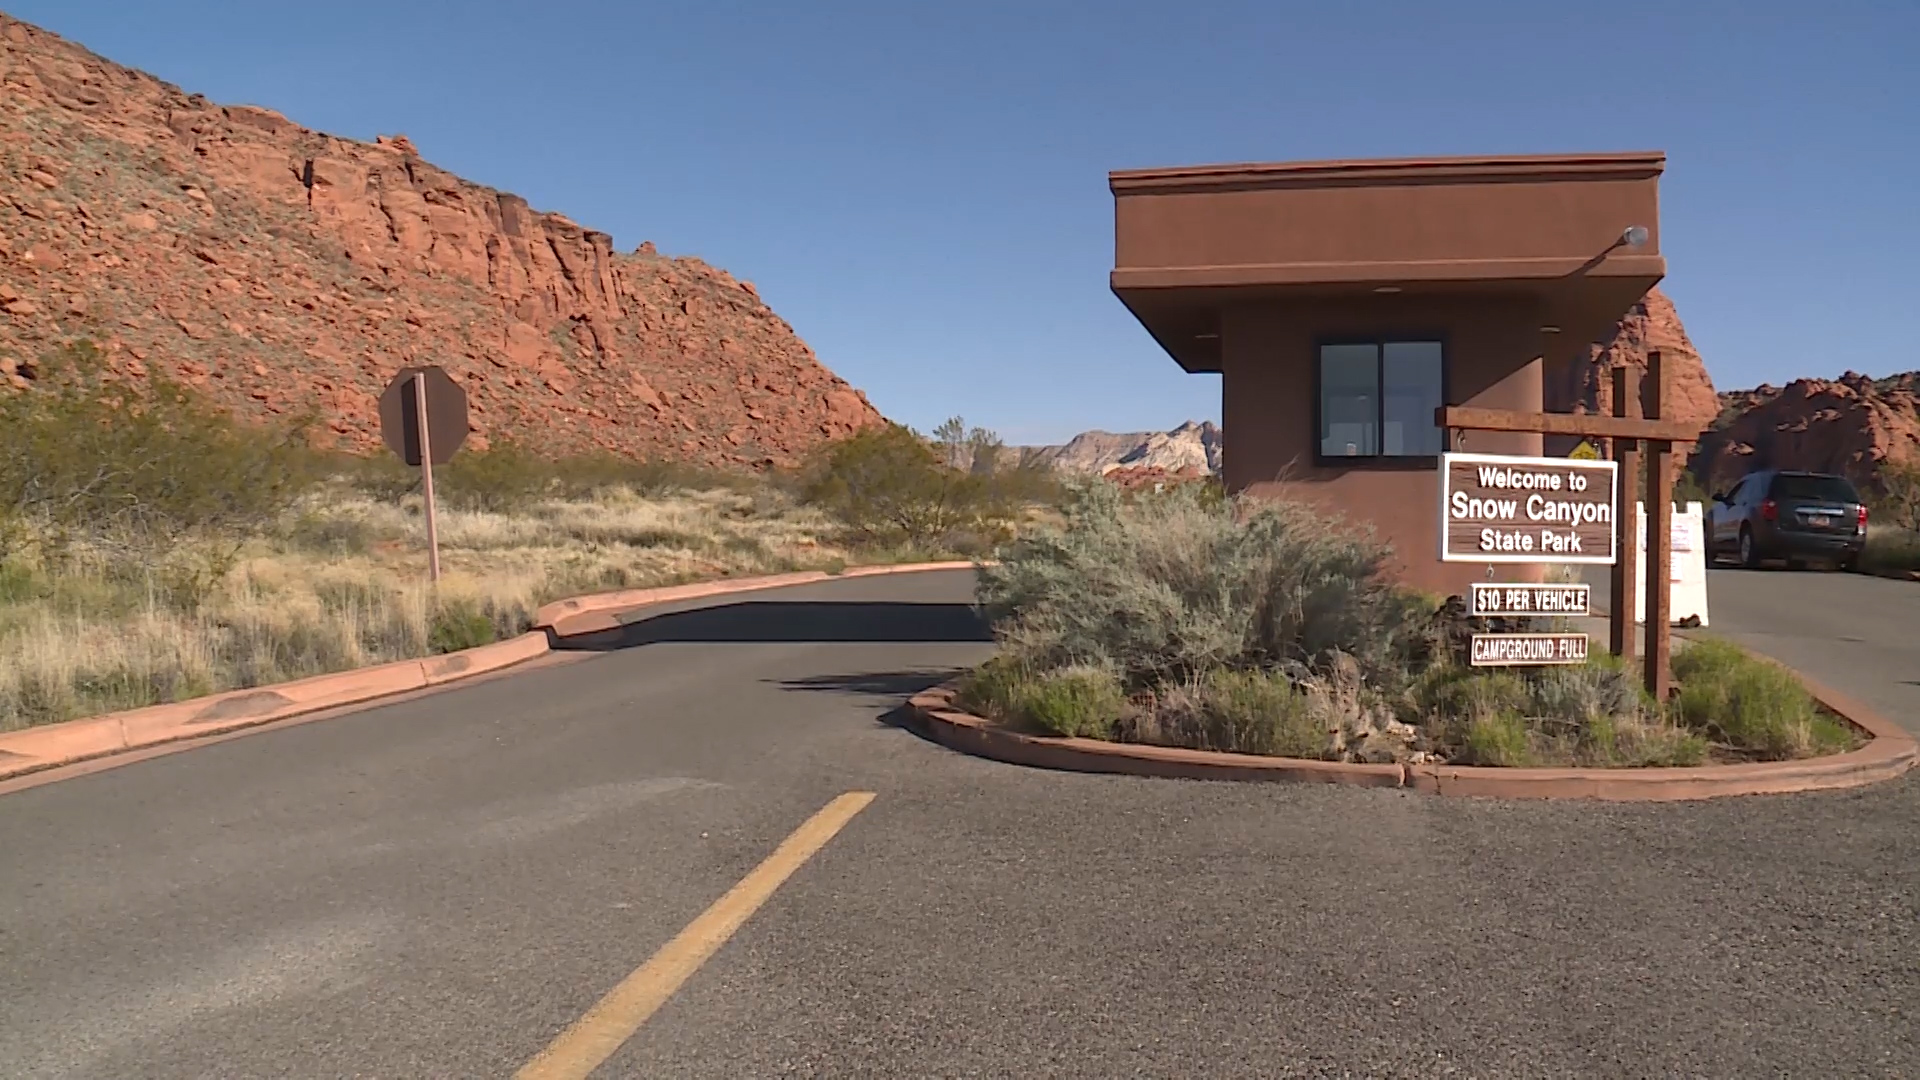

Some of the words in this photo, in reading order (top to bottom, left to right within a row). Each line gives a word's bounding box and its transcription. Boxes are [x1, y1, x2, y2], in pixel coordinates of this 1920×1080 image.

[1478, 467, 1561, 490] Welcome
[1569, 471, 1587, 491] to
[1451, 491, 1517, 519] Snow
[1526, 494, 1610, 526] Canyon
[1480, 528, 1533, 551] State
[1541, 531, 1582, 552] Park
[1478, 589, 1501, 611] $10
[1505, 590, 1530, 610] PER
[1534, 591, 1586, 611] VEHICLE
[1474, 640, 1554, 660] CAMPGROUND
[1559, 640, 1585, 658] FULL
